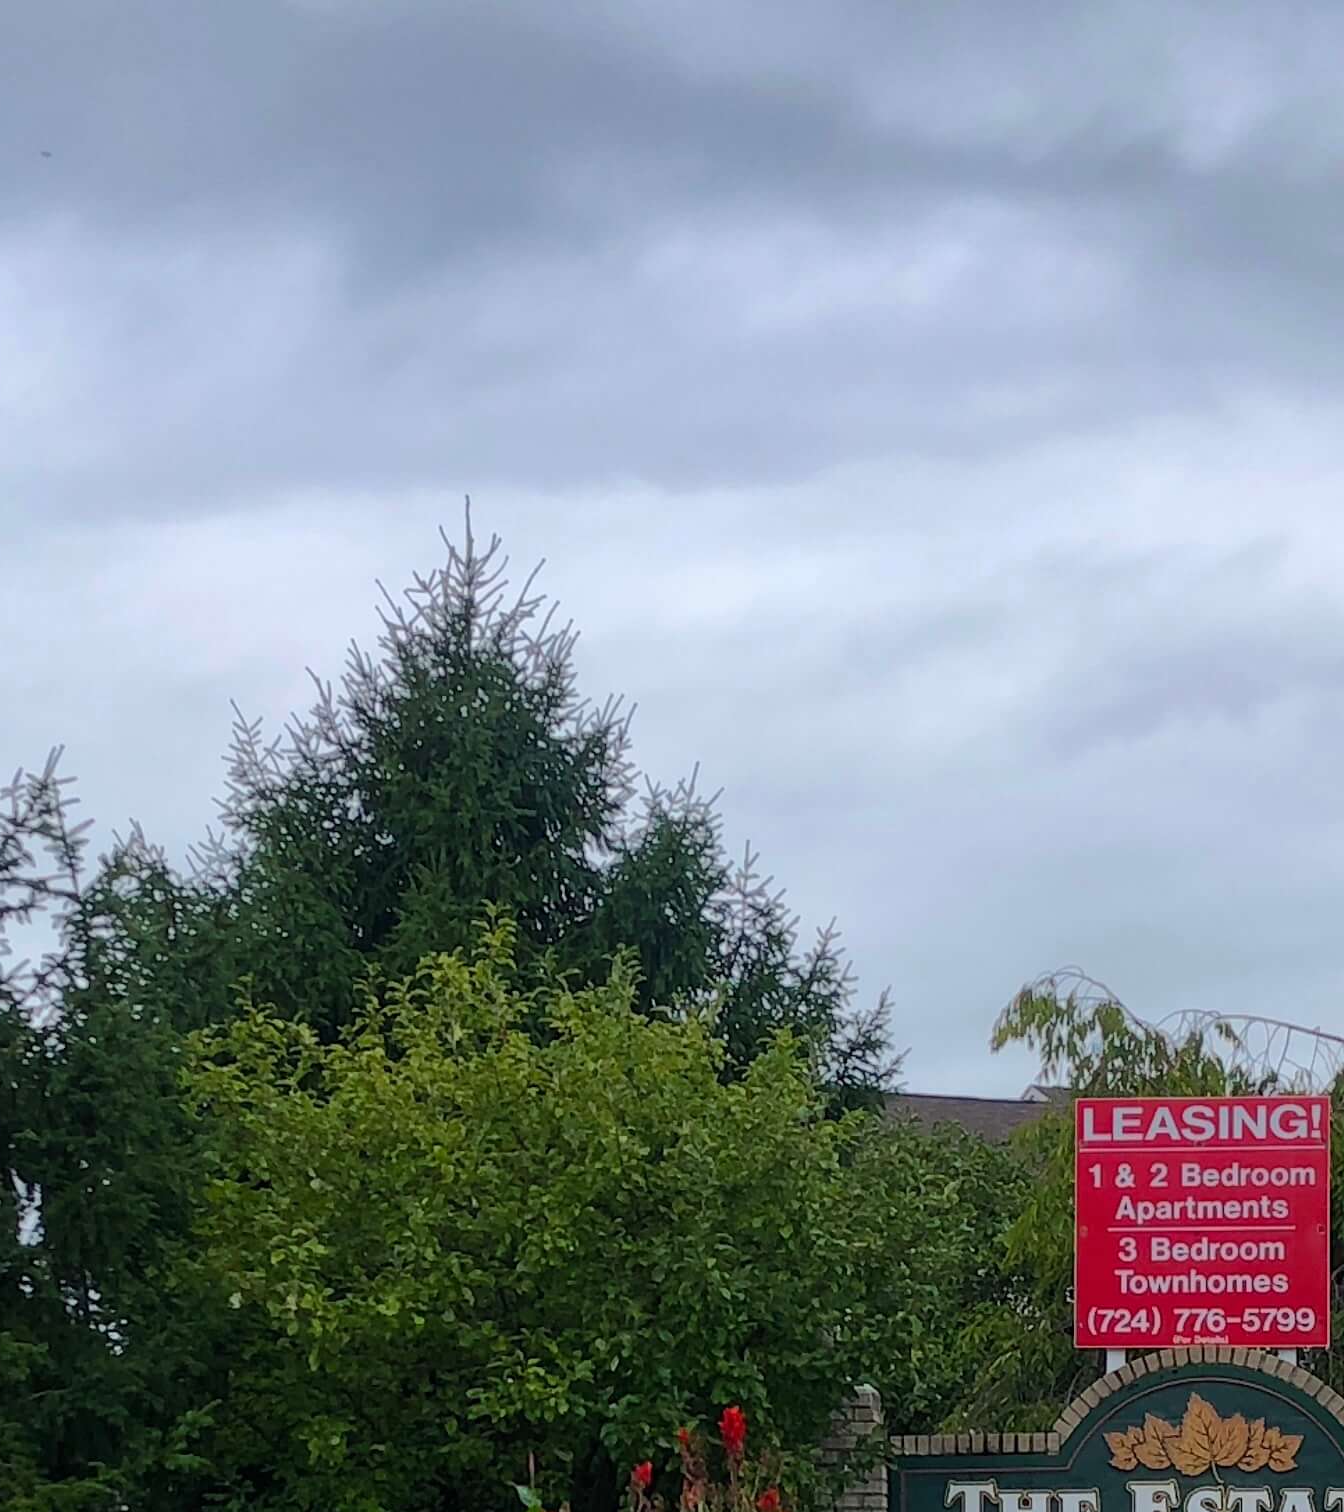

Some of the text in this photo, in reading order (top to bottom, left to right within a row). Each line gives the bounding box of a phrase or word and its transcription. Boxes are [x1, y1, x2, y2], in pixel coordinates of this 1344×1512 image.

[1082, 1103, 1322, 1142] LEASING!
[1089, 1162, 1316, 1187] 1 & 2 Bedroom
[1115, 1195, 1289, 1224] Apartments
[1118, 1236, 1285, 1261] 3 Bedroom
[1114, 1269, 1289, 1294] Townhomes
[1087, 1306, 1316, 1335] (724) 776-5799
